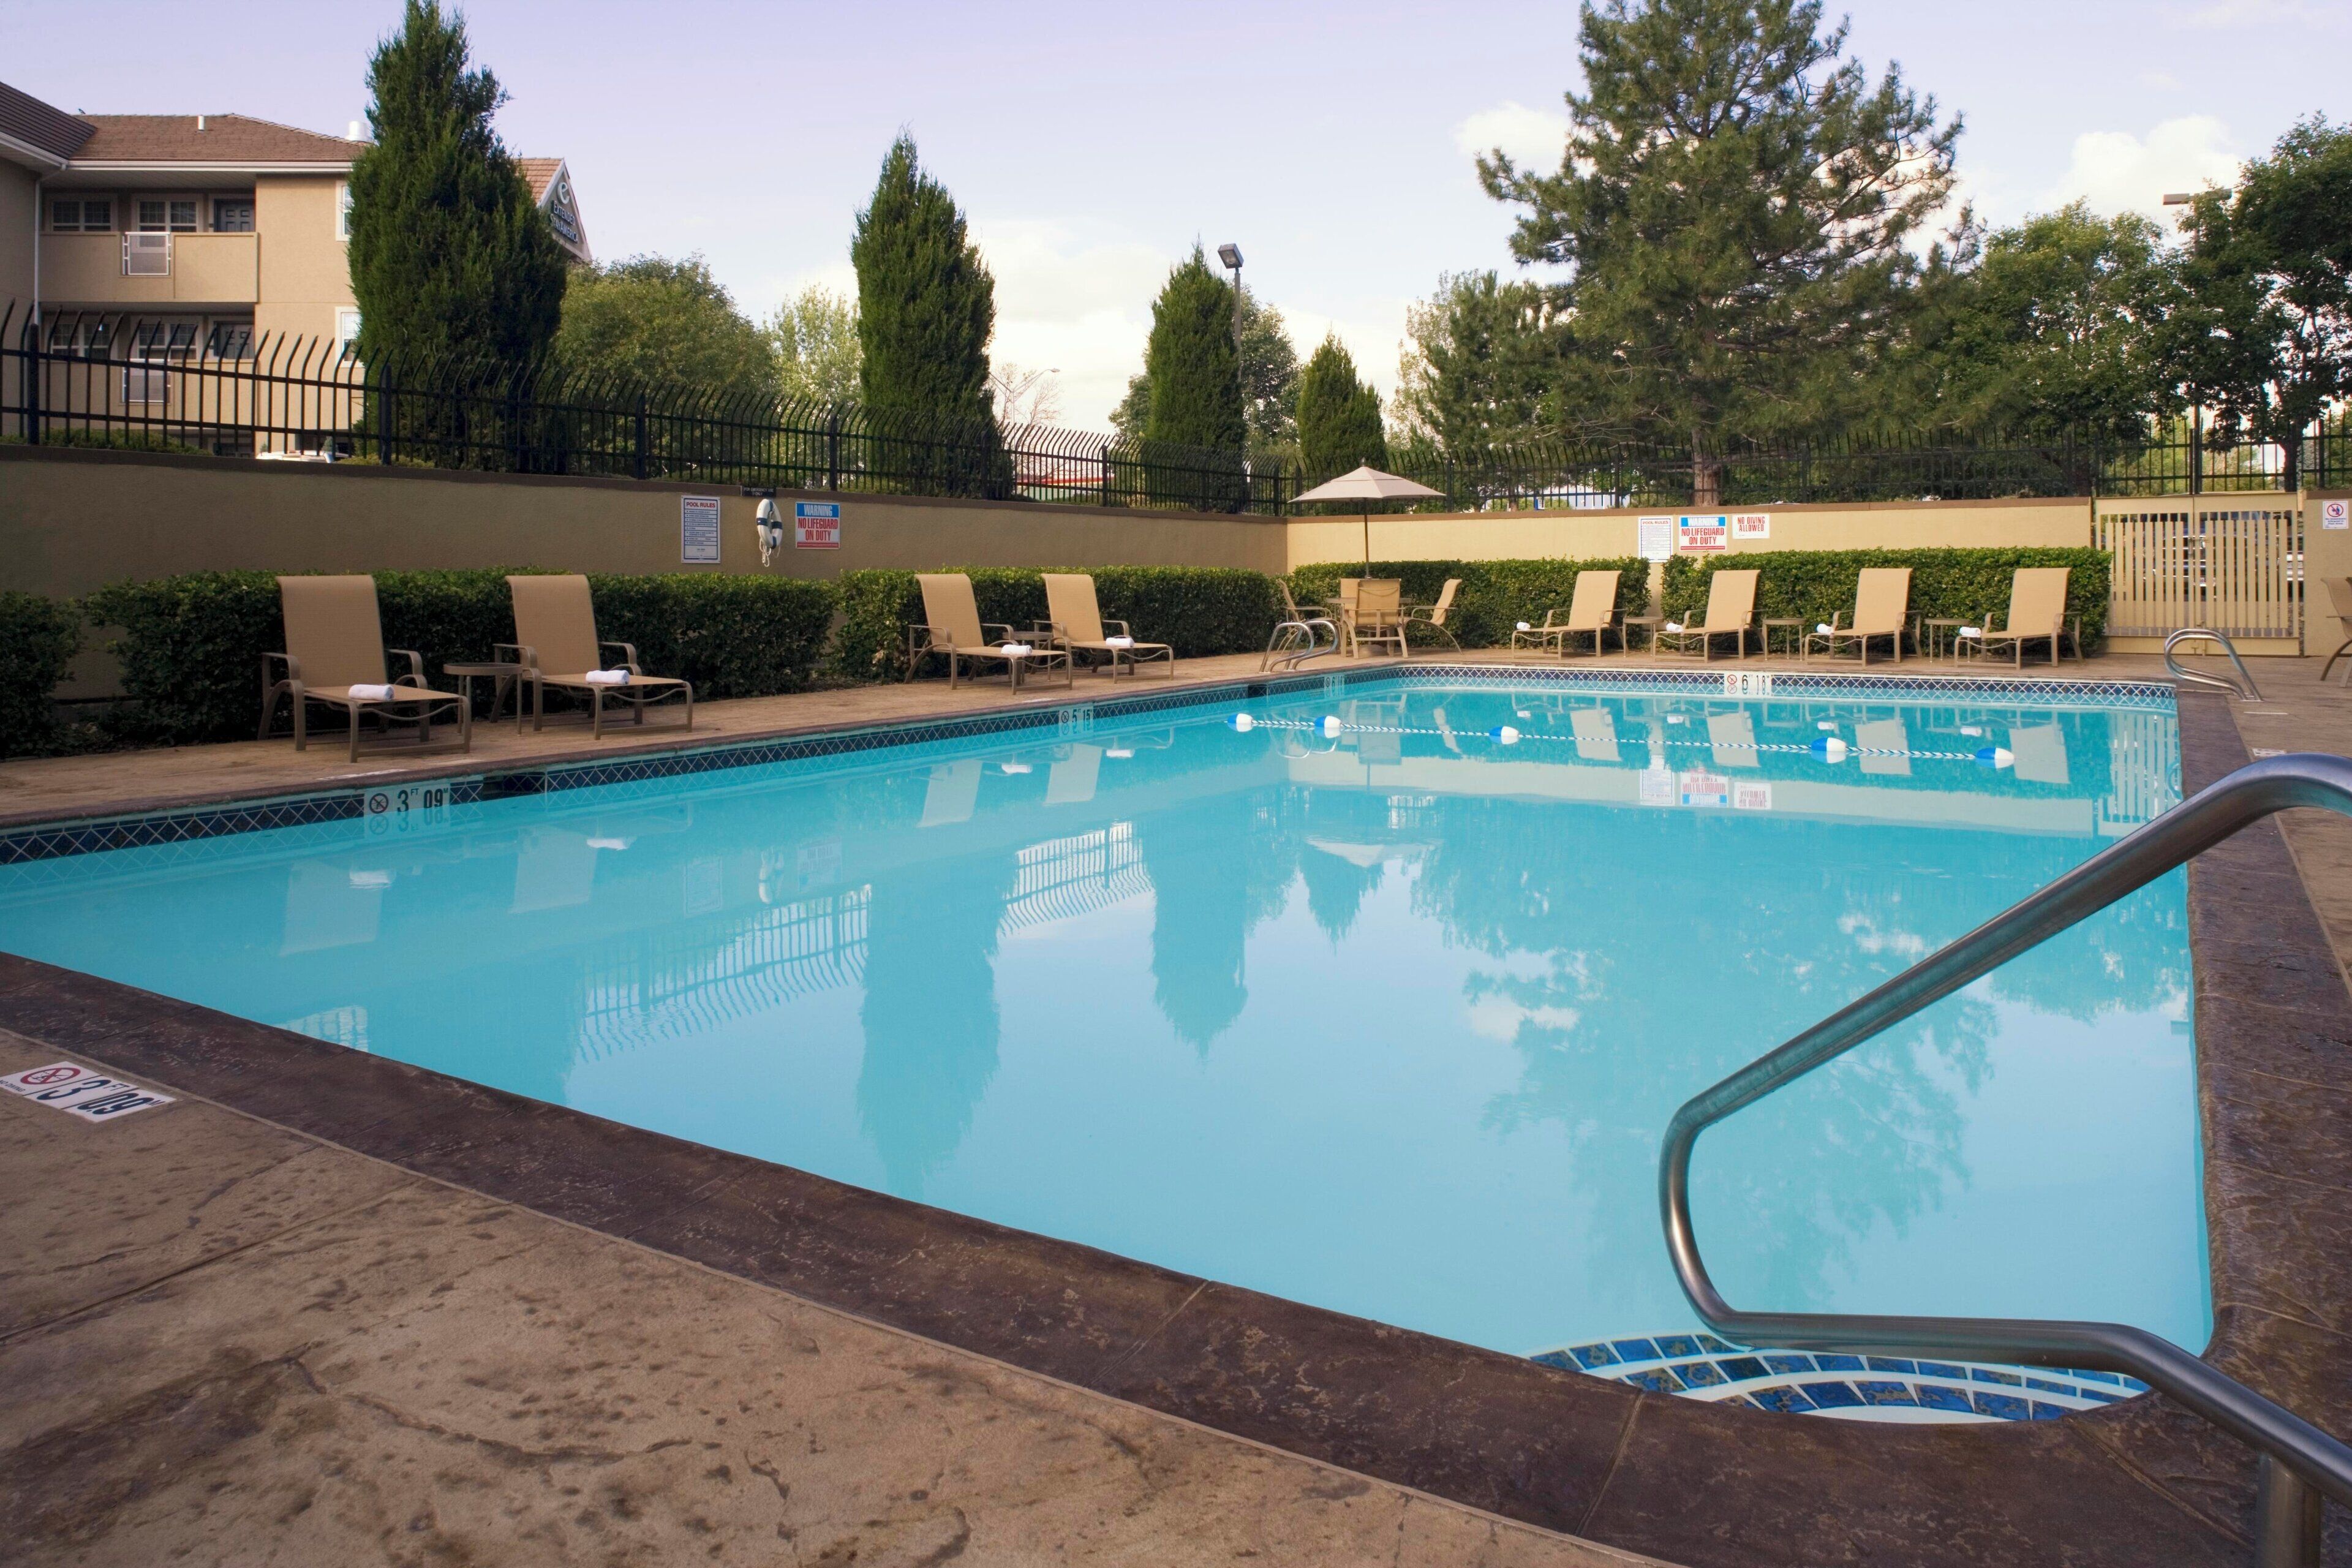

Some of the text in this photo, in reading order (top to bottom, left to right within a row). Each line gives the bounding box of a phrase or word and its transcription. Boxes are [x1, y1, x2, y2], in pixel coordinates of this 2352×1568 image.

[804, 504, 832, 516] WARNING
[798, 518, 838, 529] NO LIFEGUARD
[1687, 518, 1719, 527] WARNING
[805, 529, 831, 541] ON DUTY
[1691, 527, 1724, 536] LIFEGUARD
[397, 790, 409, 812] 3
[5, 1083, 26, 1092] DIVING
[37, 1079, 130, 1100] 3 FT
